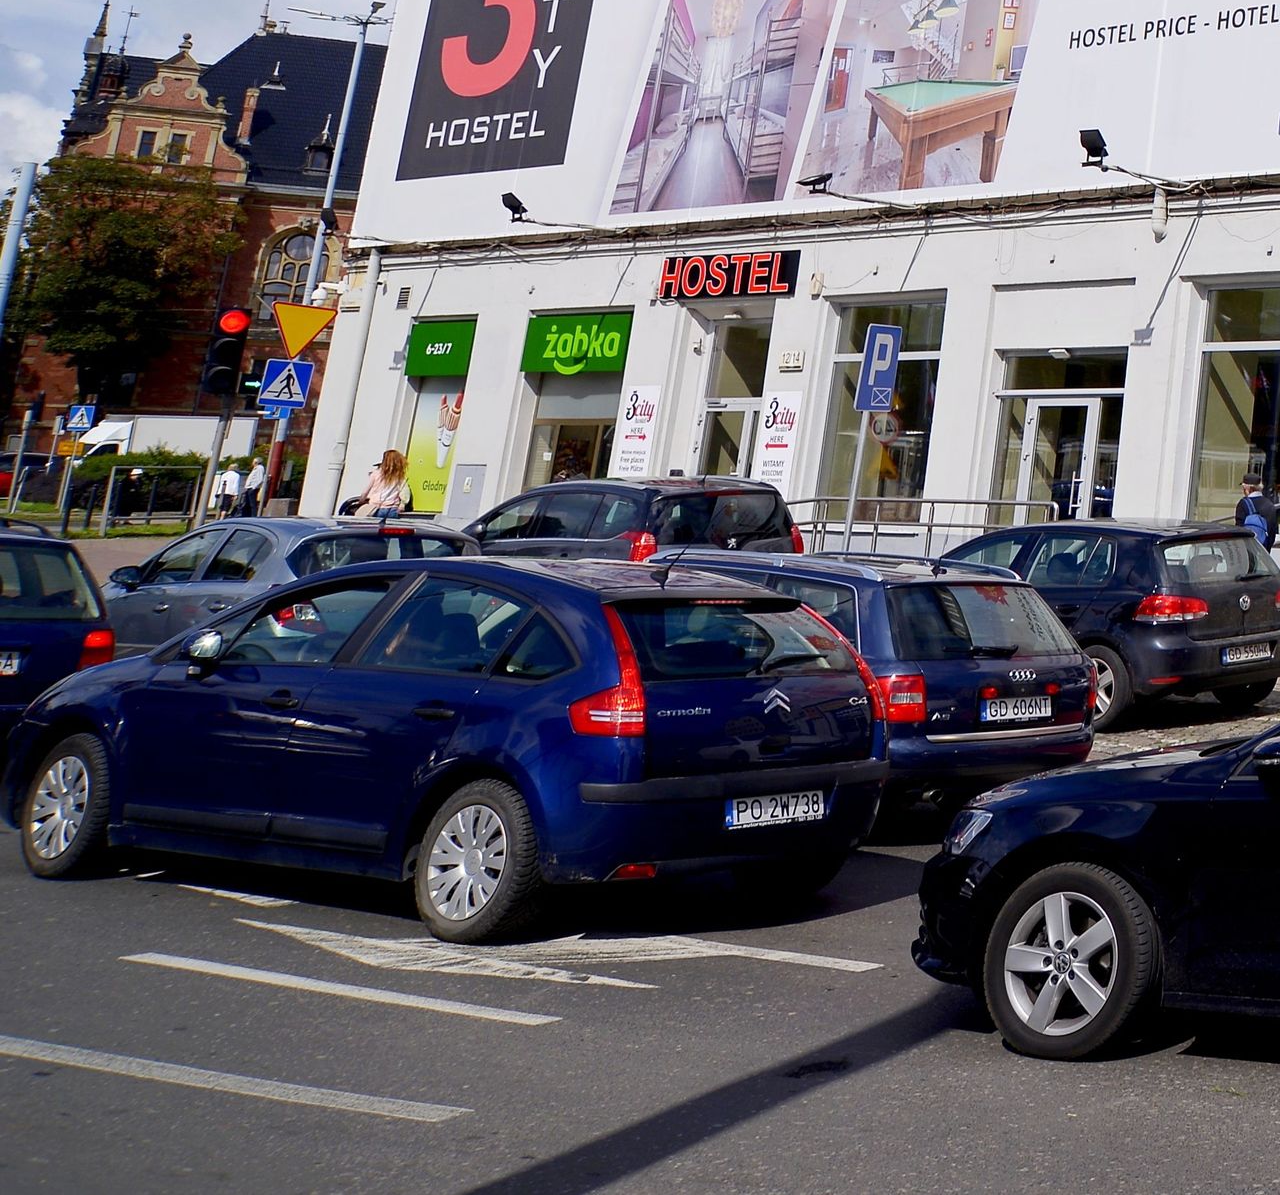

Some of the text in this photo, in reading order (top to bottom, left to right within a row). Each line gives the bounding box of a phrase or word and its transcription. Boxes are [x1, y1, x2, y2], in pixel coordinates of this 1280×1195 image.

[1068, 23, 1137, 49] HOSTEL
[1143, 14, 1197, 41] PRICE
[1216, 3, 1280, 31] HOTEL
[425, 110, 545, 149] HOSTEL
[658, 251, 790, 299] HOSTEL
[426, 343, 452, 355] 6-23/7
[542, 325, 620, 358] żabka
[868, 333, 893, 386] P
[1228, 647, 1241, 660] GD
[989, 698, 1049, 718] GD 606NT
[736, 793, 820, 822] PO 2W738
